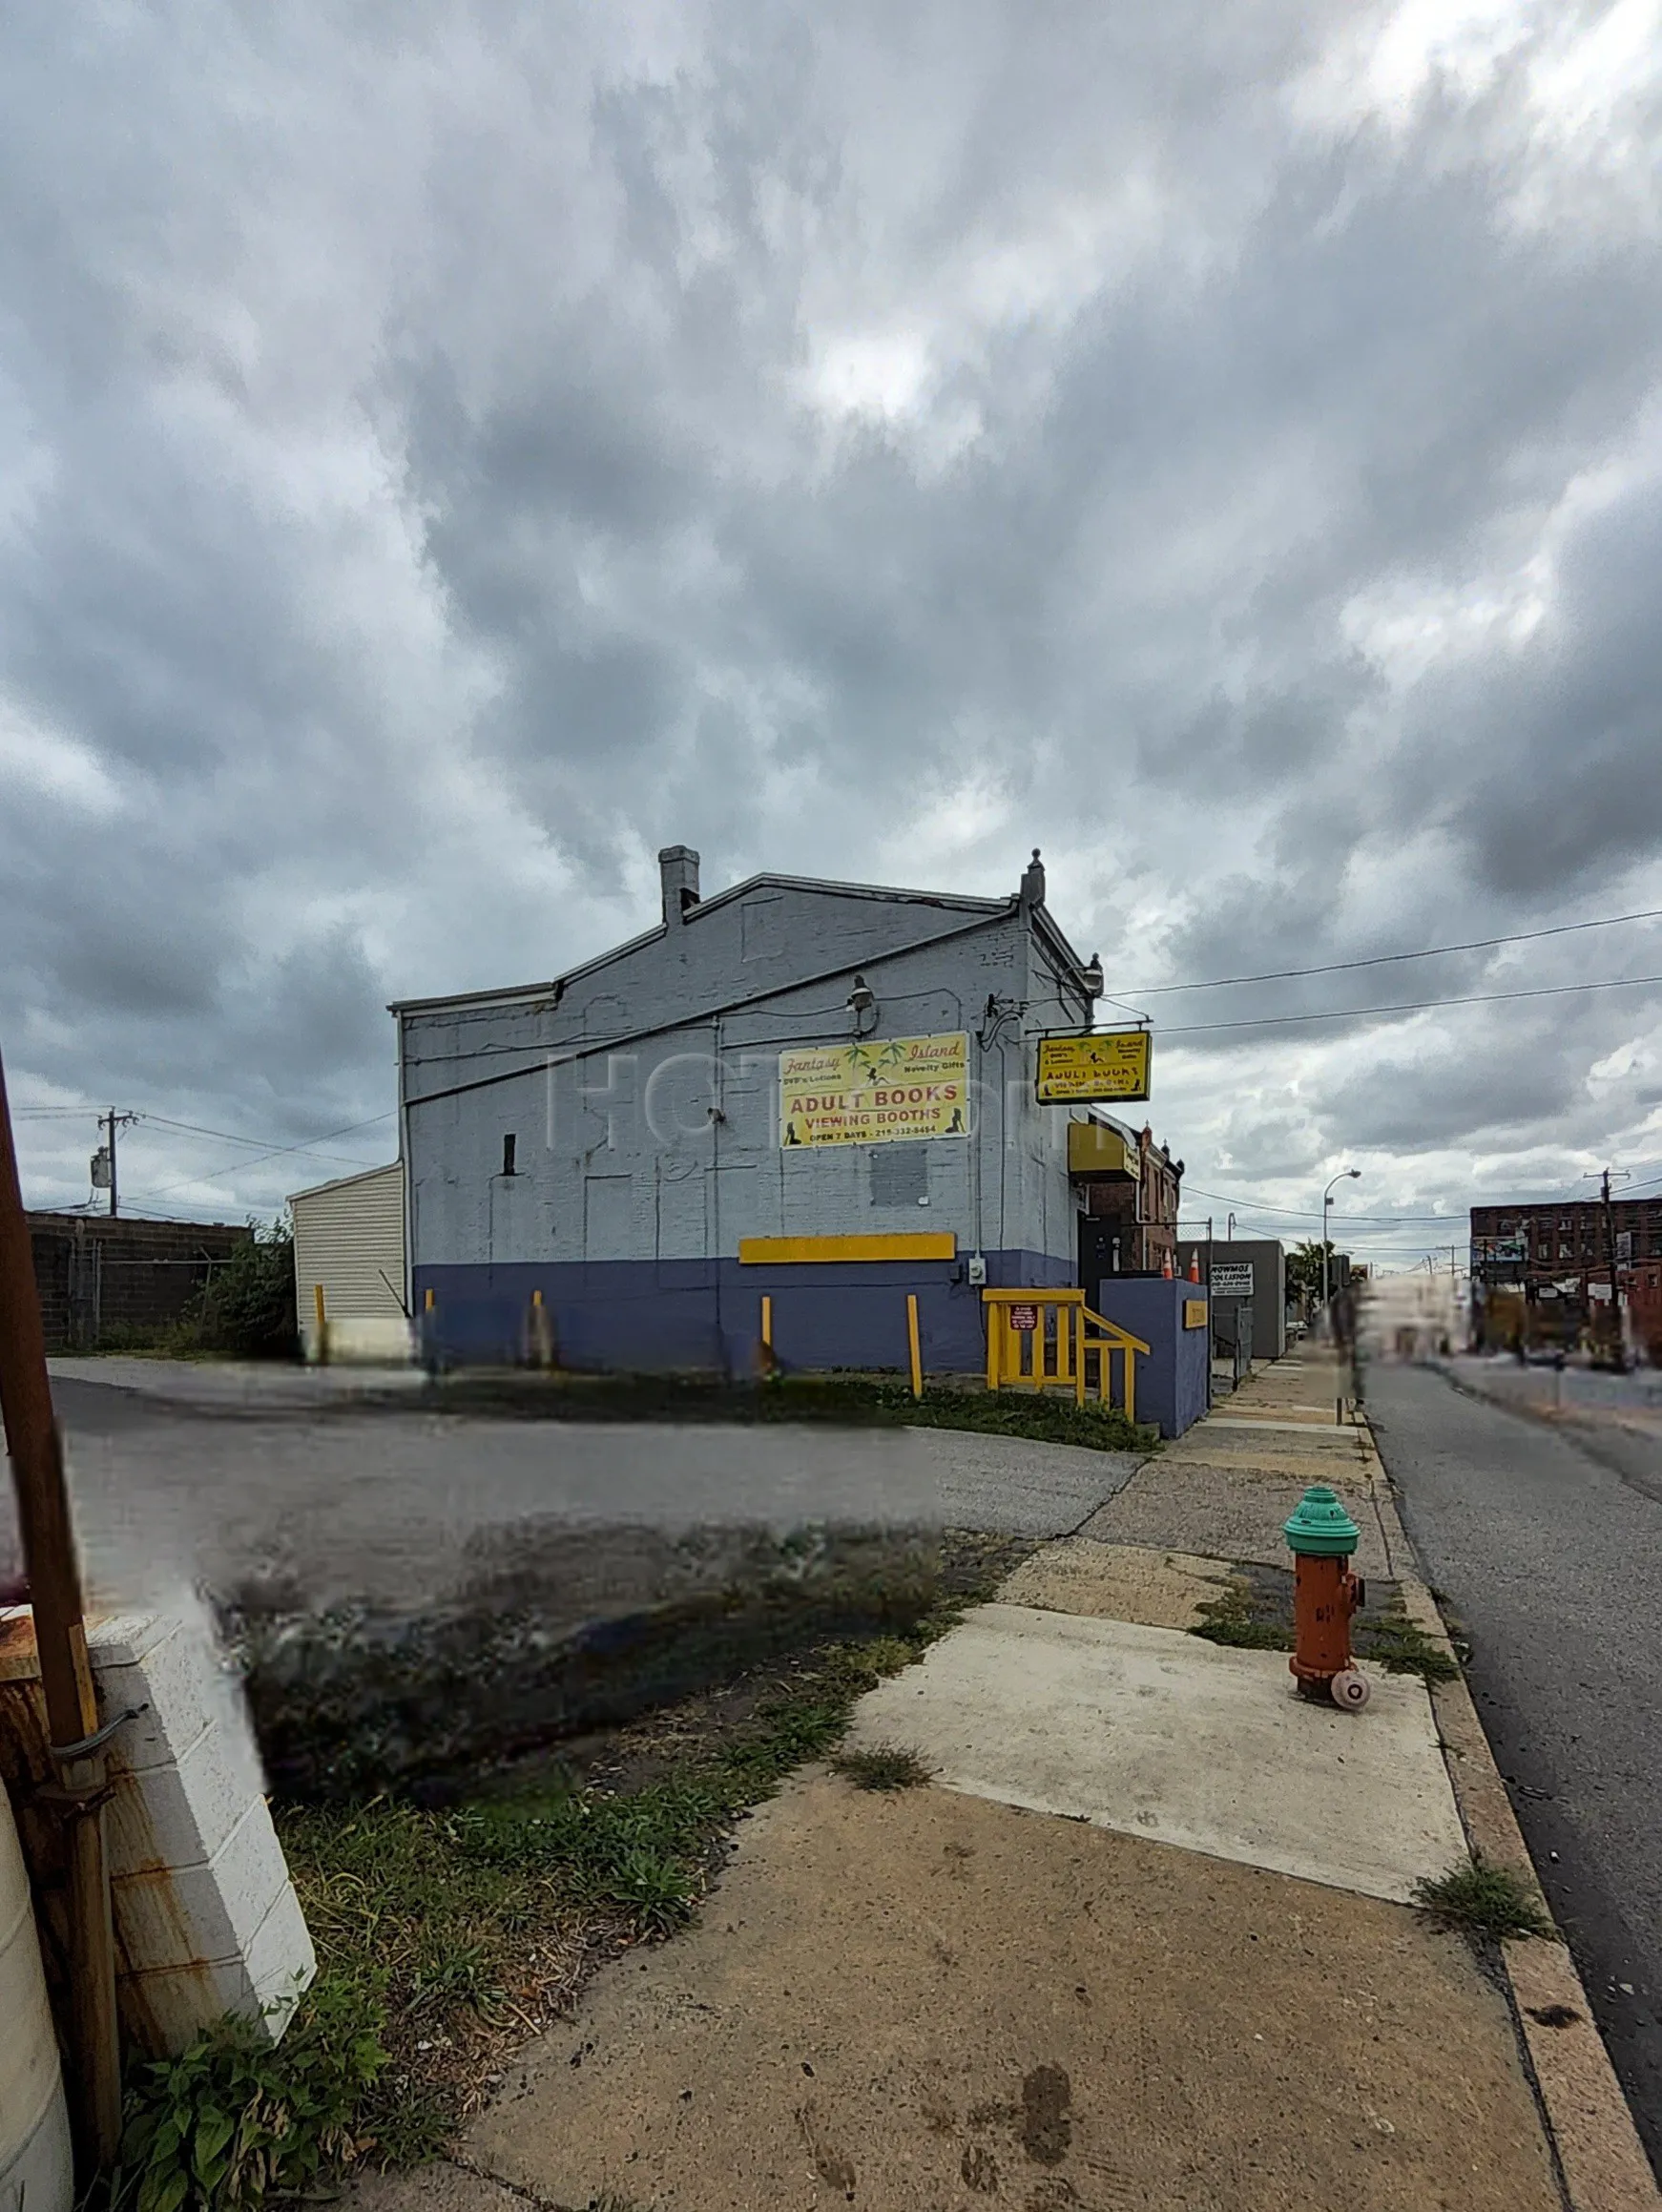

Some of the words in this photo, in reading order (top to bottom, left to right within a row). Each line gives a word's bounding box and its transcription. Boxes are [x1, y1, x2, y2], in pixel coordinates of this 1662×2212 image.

[909, 1041, 961, 1060] Island
[783, 1057, 841, 1075] Fantasy
[942, 1061, 965, 1070] Gifts
[790, 1093, 864, 1114] ADULT
[875, 1085, 957, 1106] BOOKS
[805, 1114, 870, 1129] VIEWING
[877, 1108, 941, 1124] BOOTHS
[810, 1133, 833, 1142] OPEN
[844, 1131, 867, 1139] DAYS
